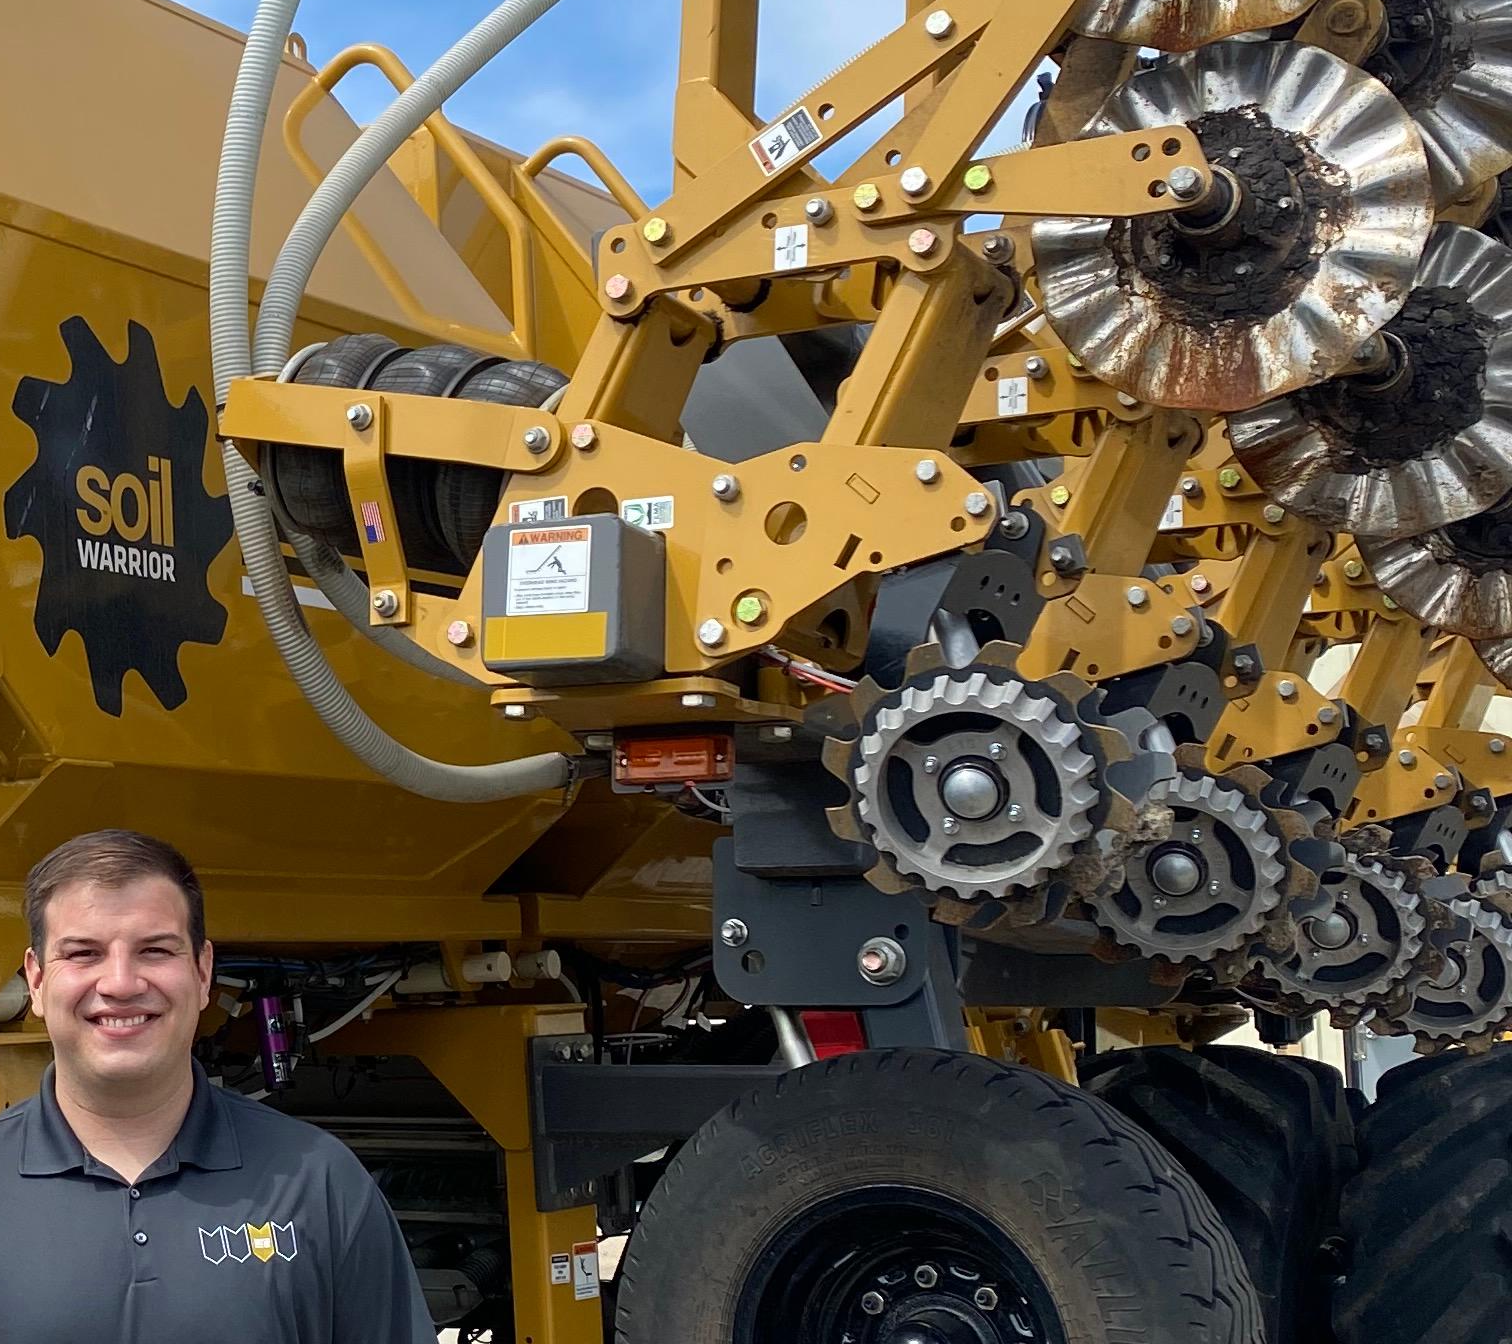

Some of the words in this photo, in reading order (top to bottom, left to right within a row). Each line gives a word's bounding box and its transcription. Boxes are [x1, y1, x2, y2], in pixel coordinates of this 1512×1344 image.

[76, 455, 175, 548] soil
[530, 530, 583, 543] WARNING
[77, 538, 177, 583] WARRIOR
